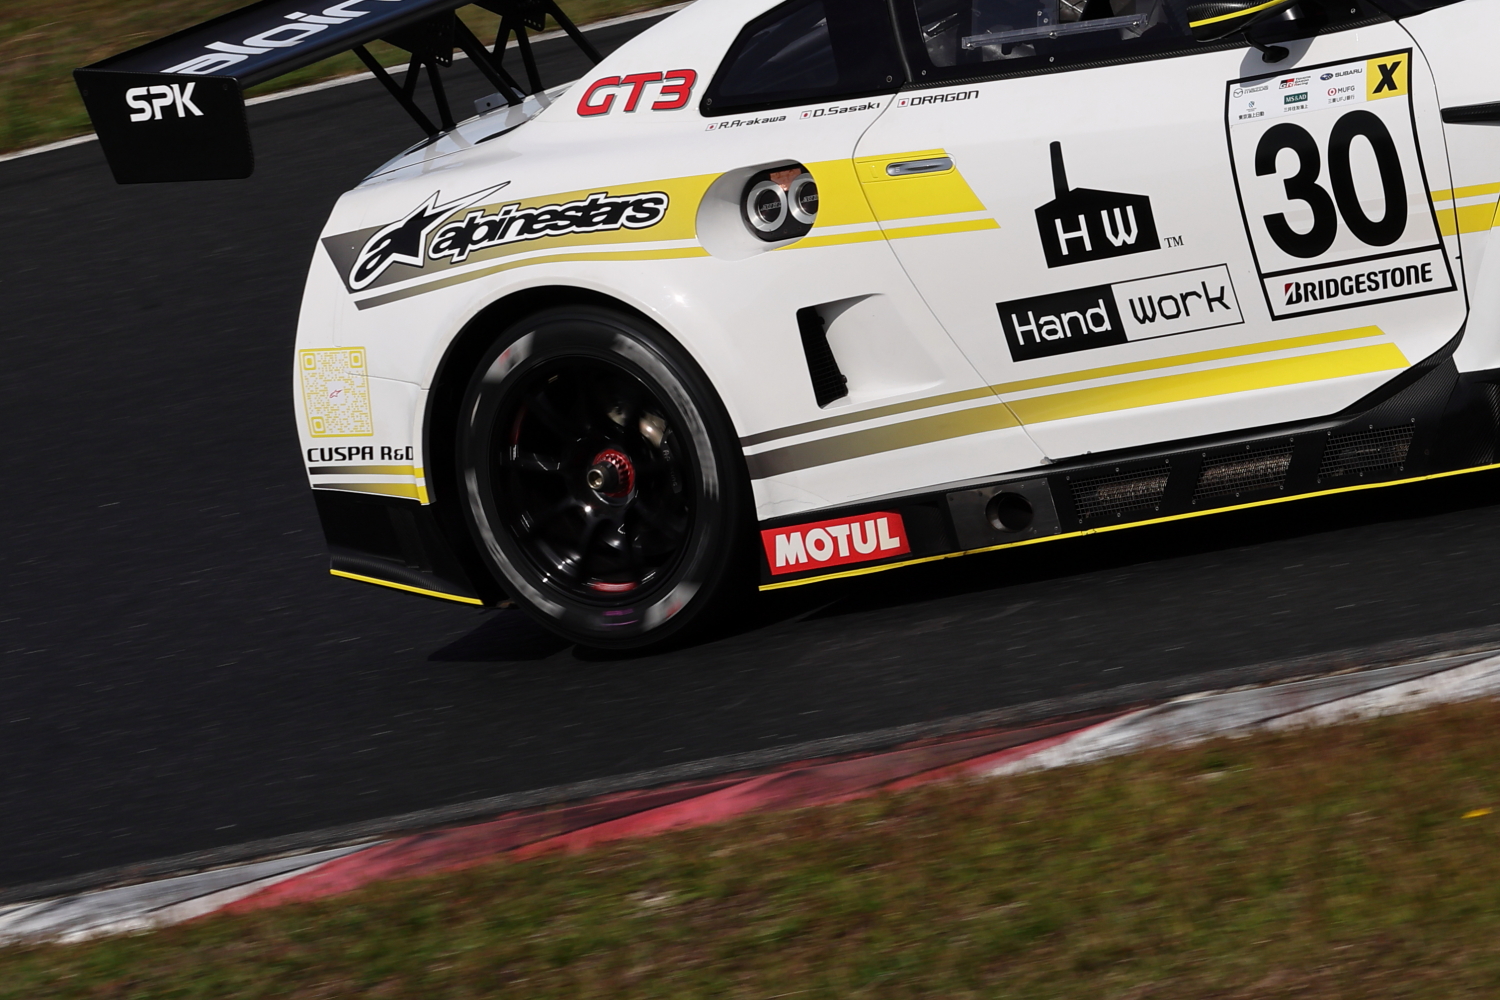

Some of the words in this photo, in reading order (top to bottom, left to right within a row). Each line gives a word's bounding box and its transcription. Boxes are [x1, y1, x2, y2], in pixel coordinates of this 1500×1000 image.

[1335, 68, 1363, 78] SUBARU
[1338, 85, 1355, 93] MUFG
[1372, 60, 1402, 94] X
[126, 82, 204, 122] SPK
[577, 69, 697, 118] GT3
[812, 102, 880, 118] D.Sasaki
[910, 90, 979, 106] DRAGON
[1286, 94, 1307, 102] MS&AD
[718, 115, 786, 130] R.Arakawa
[1255, 110, 1408, 258] 30
[430, 193, 669, 262] alpinestars
[1284, 262, 1433, 305] BRIDGESTONE
[1011, 299, 1112, 345] Hand
[1129, 281, 1231, 325] work
[307, 446, 374, 462] CUSPA
[775, 517, 900, 567] MOTUL
